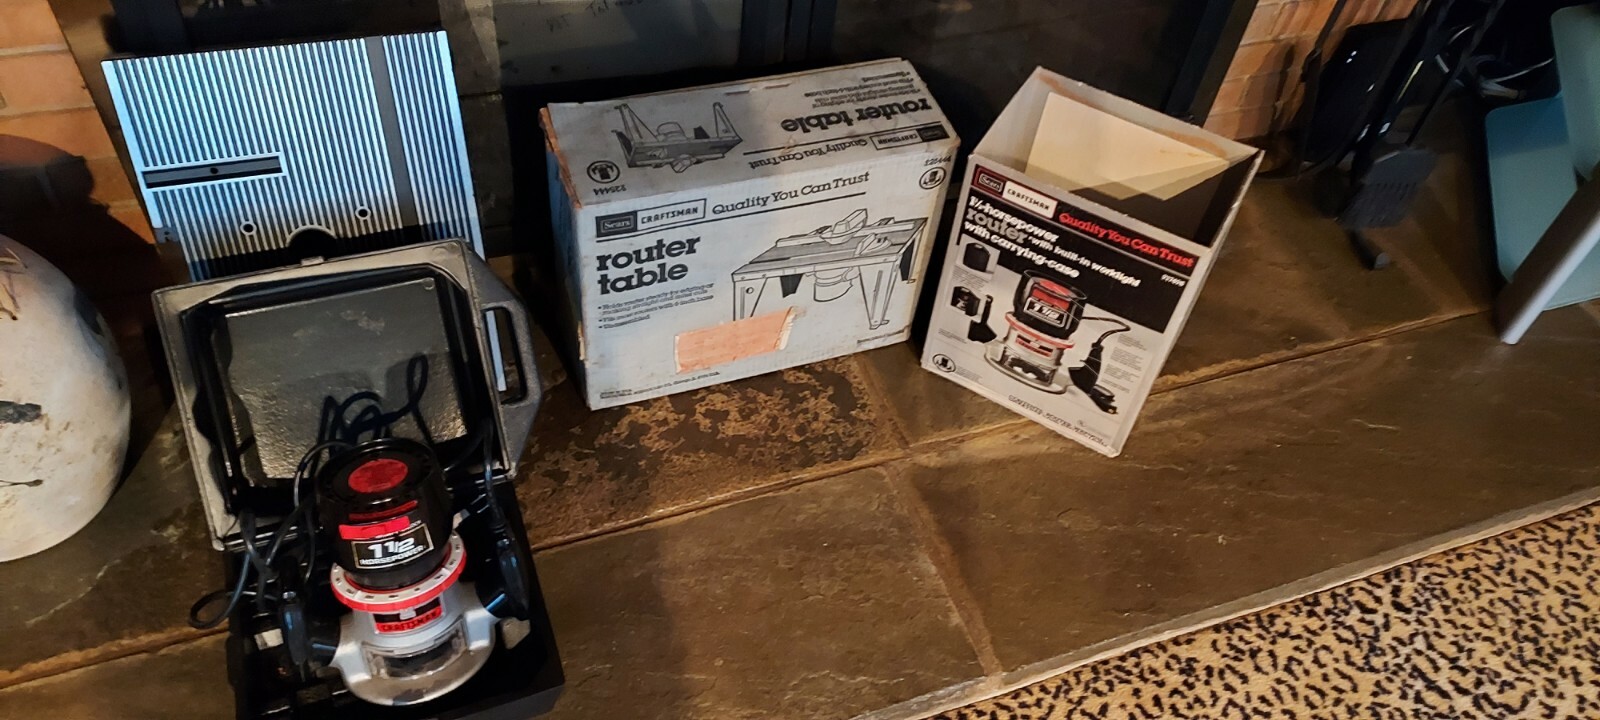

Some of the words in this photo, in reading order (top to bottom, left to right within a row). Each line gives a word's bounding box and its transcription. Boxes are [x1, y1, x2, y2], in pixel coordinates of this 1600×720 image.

[855, 98, 932, 121] router
[781, 110, 853, 134] table
[825, 138, 868, 153] Quality
[748, 155, 780, 169] Trust
[712, 194, 770, 215] Quality
[771, 189, 799, 203] You
[801, 182, 832, 196] Can
[832, 171, 870, 189] Trust
[1007, 188, 1051, 211] CRAFTSMAN
[604, 217, 631, 230] Sears
[641, 207, 699, 225] CRAFTSMAN
[966, 208, 1029, 244] router
[963, 221, 991, 240] with
[1058, 212, 1109, 238] Quality
[1105, 229, 1131, 246] You
[1131, 238, 1160, 257] Can
[1159, 248, 1195, 268] Trust
[596, 236, 701, 272] router
[598, 262, 689, 295] table
[360, 545, 425, 566] HORSEPOWER
